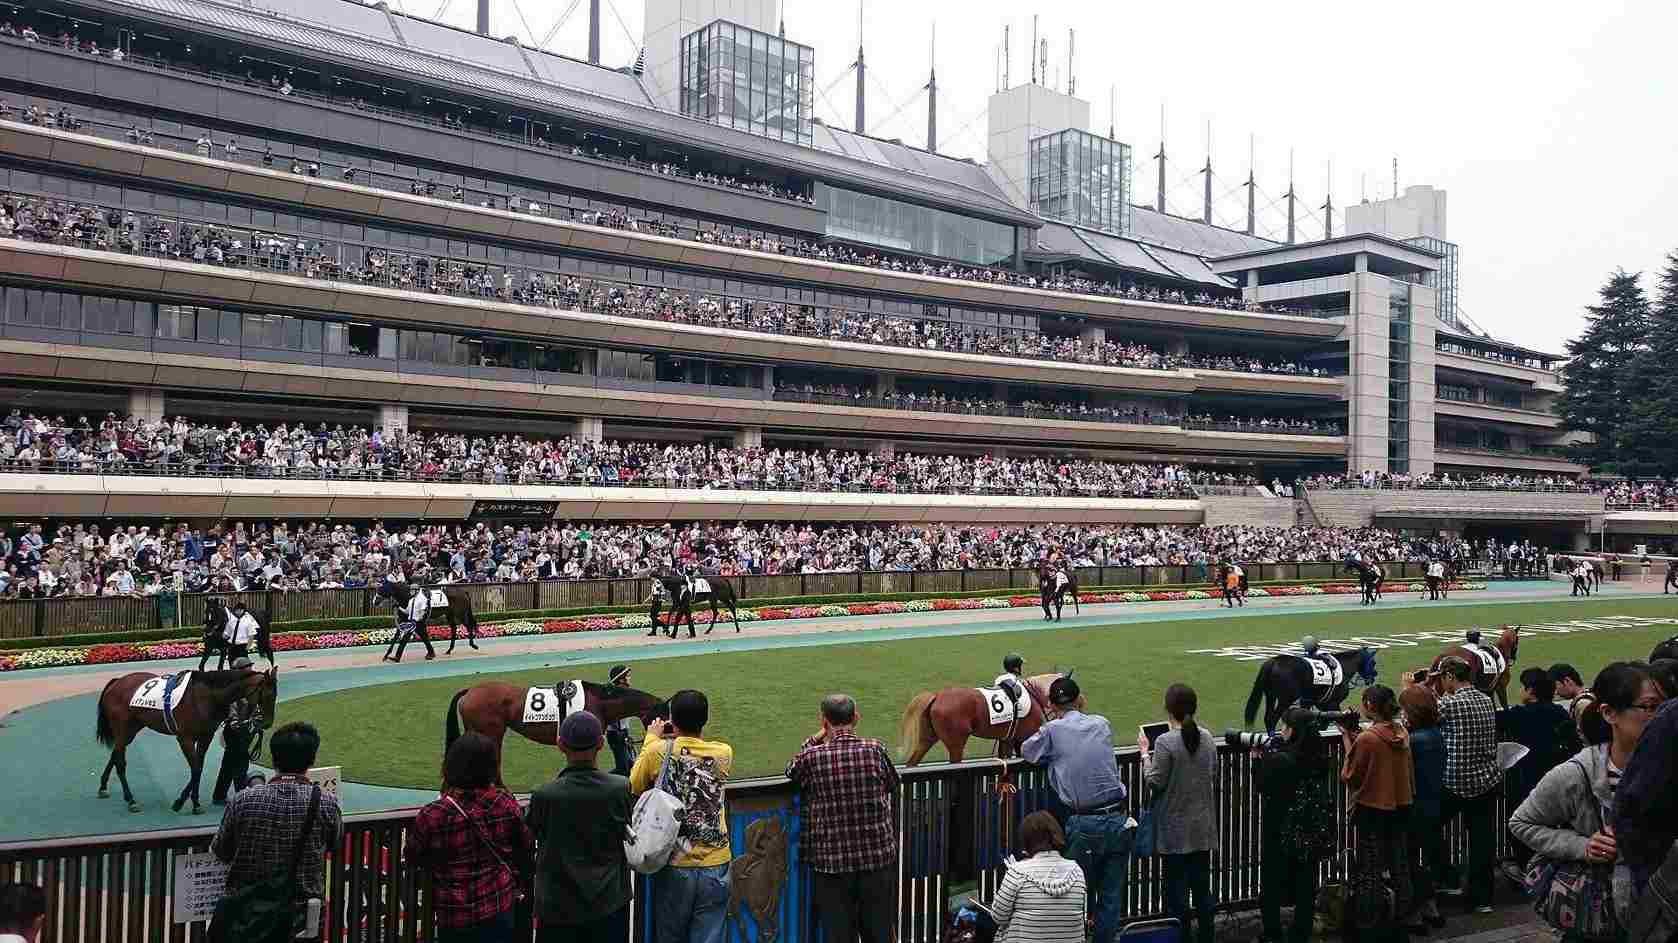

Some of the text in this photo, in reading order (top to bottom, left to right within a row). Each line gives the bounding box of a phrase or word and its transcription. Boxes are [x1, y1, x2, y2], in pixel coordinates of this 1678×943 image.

[1482, 652, 1492, 667] 4
[1312, 661, 1325, 677] 5
[142, 679, 160, 697] 9
[530, 692, 546, 712] 8
[991, 693, 1004, 713] 6
